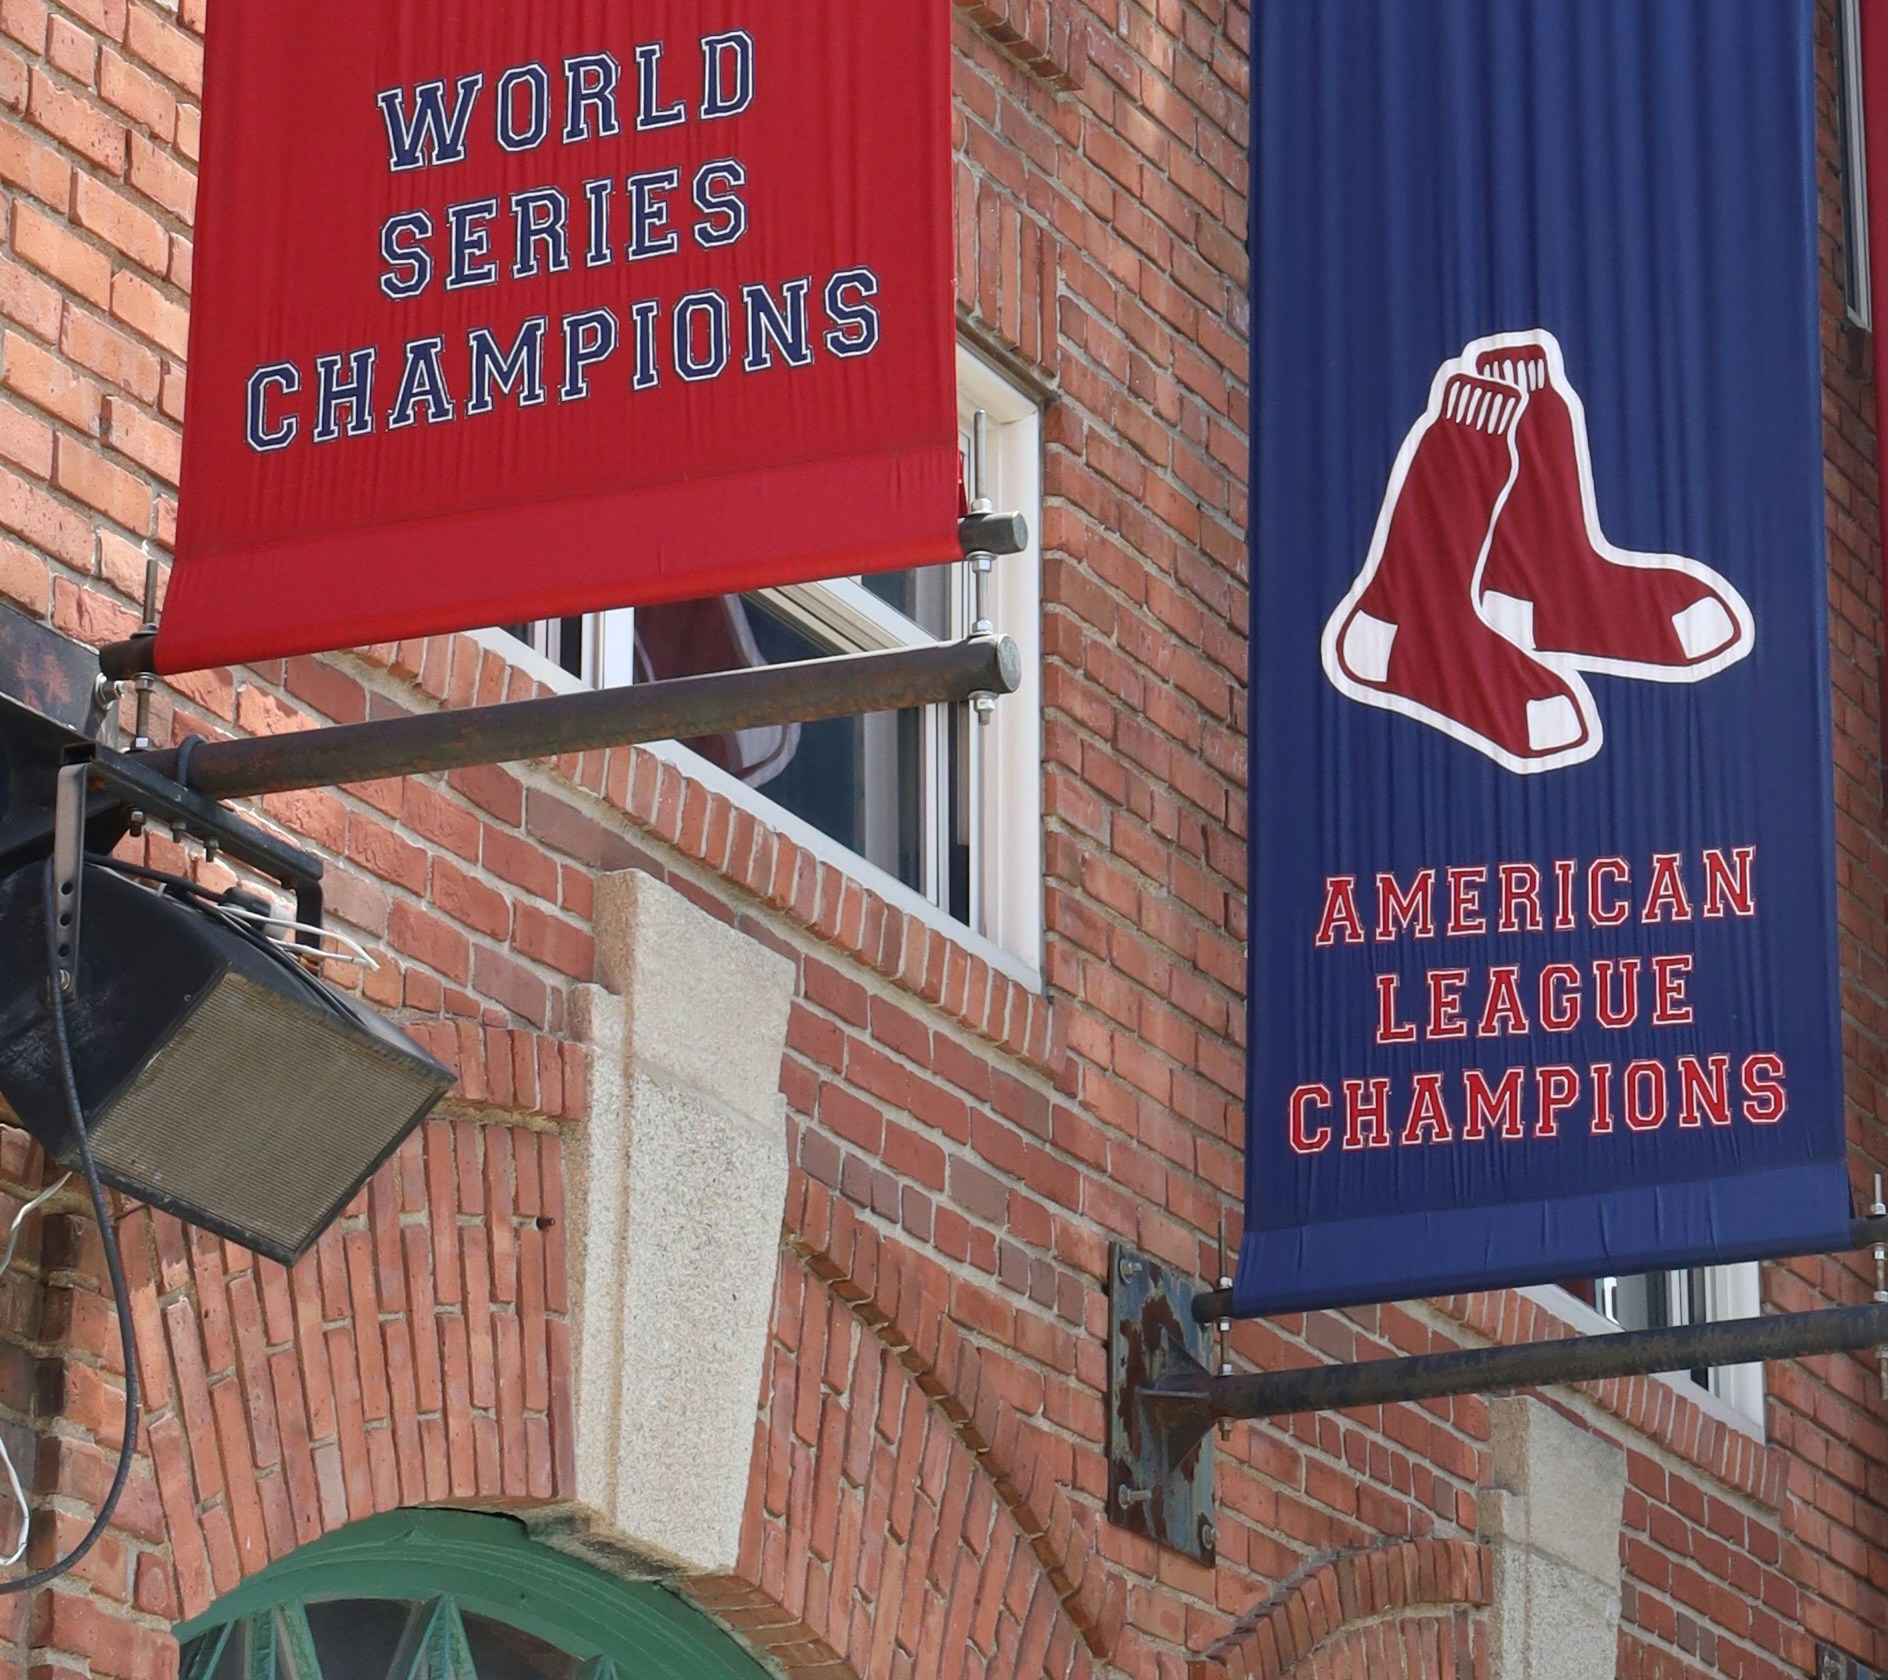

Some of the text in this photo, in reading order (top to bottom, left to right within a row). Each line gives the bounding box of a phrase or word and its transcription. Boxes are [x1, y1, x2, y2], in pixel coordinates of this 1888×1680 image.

[376, 27, 756, 173] WORLD
[378, 155, 749, 301] SERIES
[244, 265, 881, 454] CHAMPIONS
[1314, 844, 1757, 947] AMERICAN
[1374, 952, 1696, 1045] LEAGUE
[1287, 1051, 1788, 1154] CHAMPIONS
